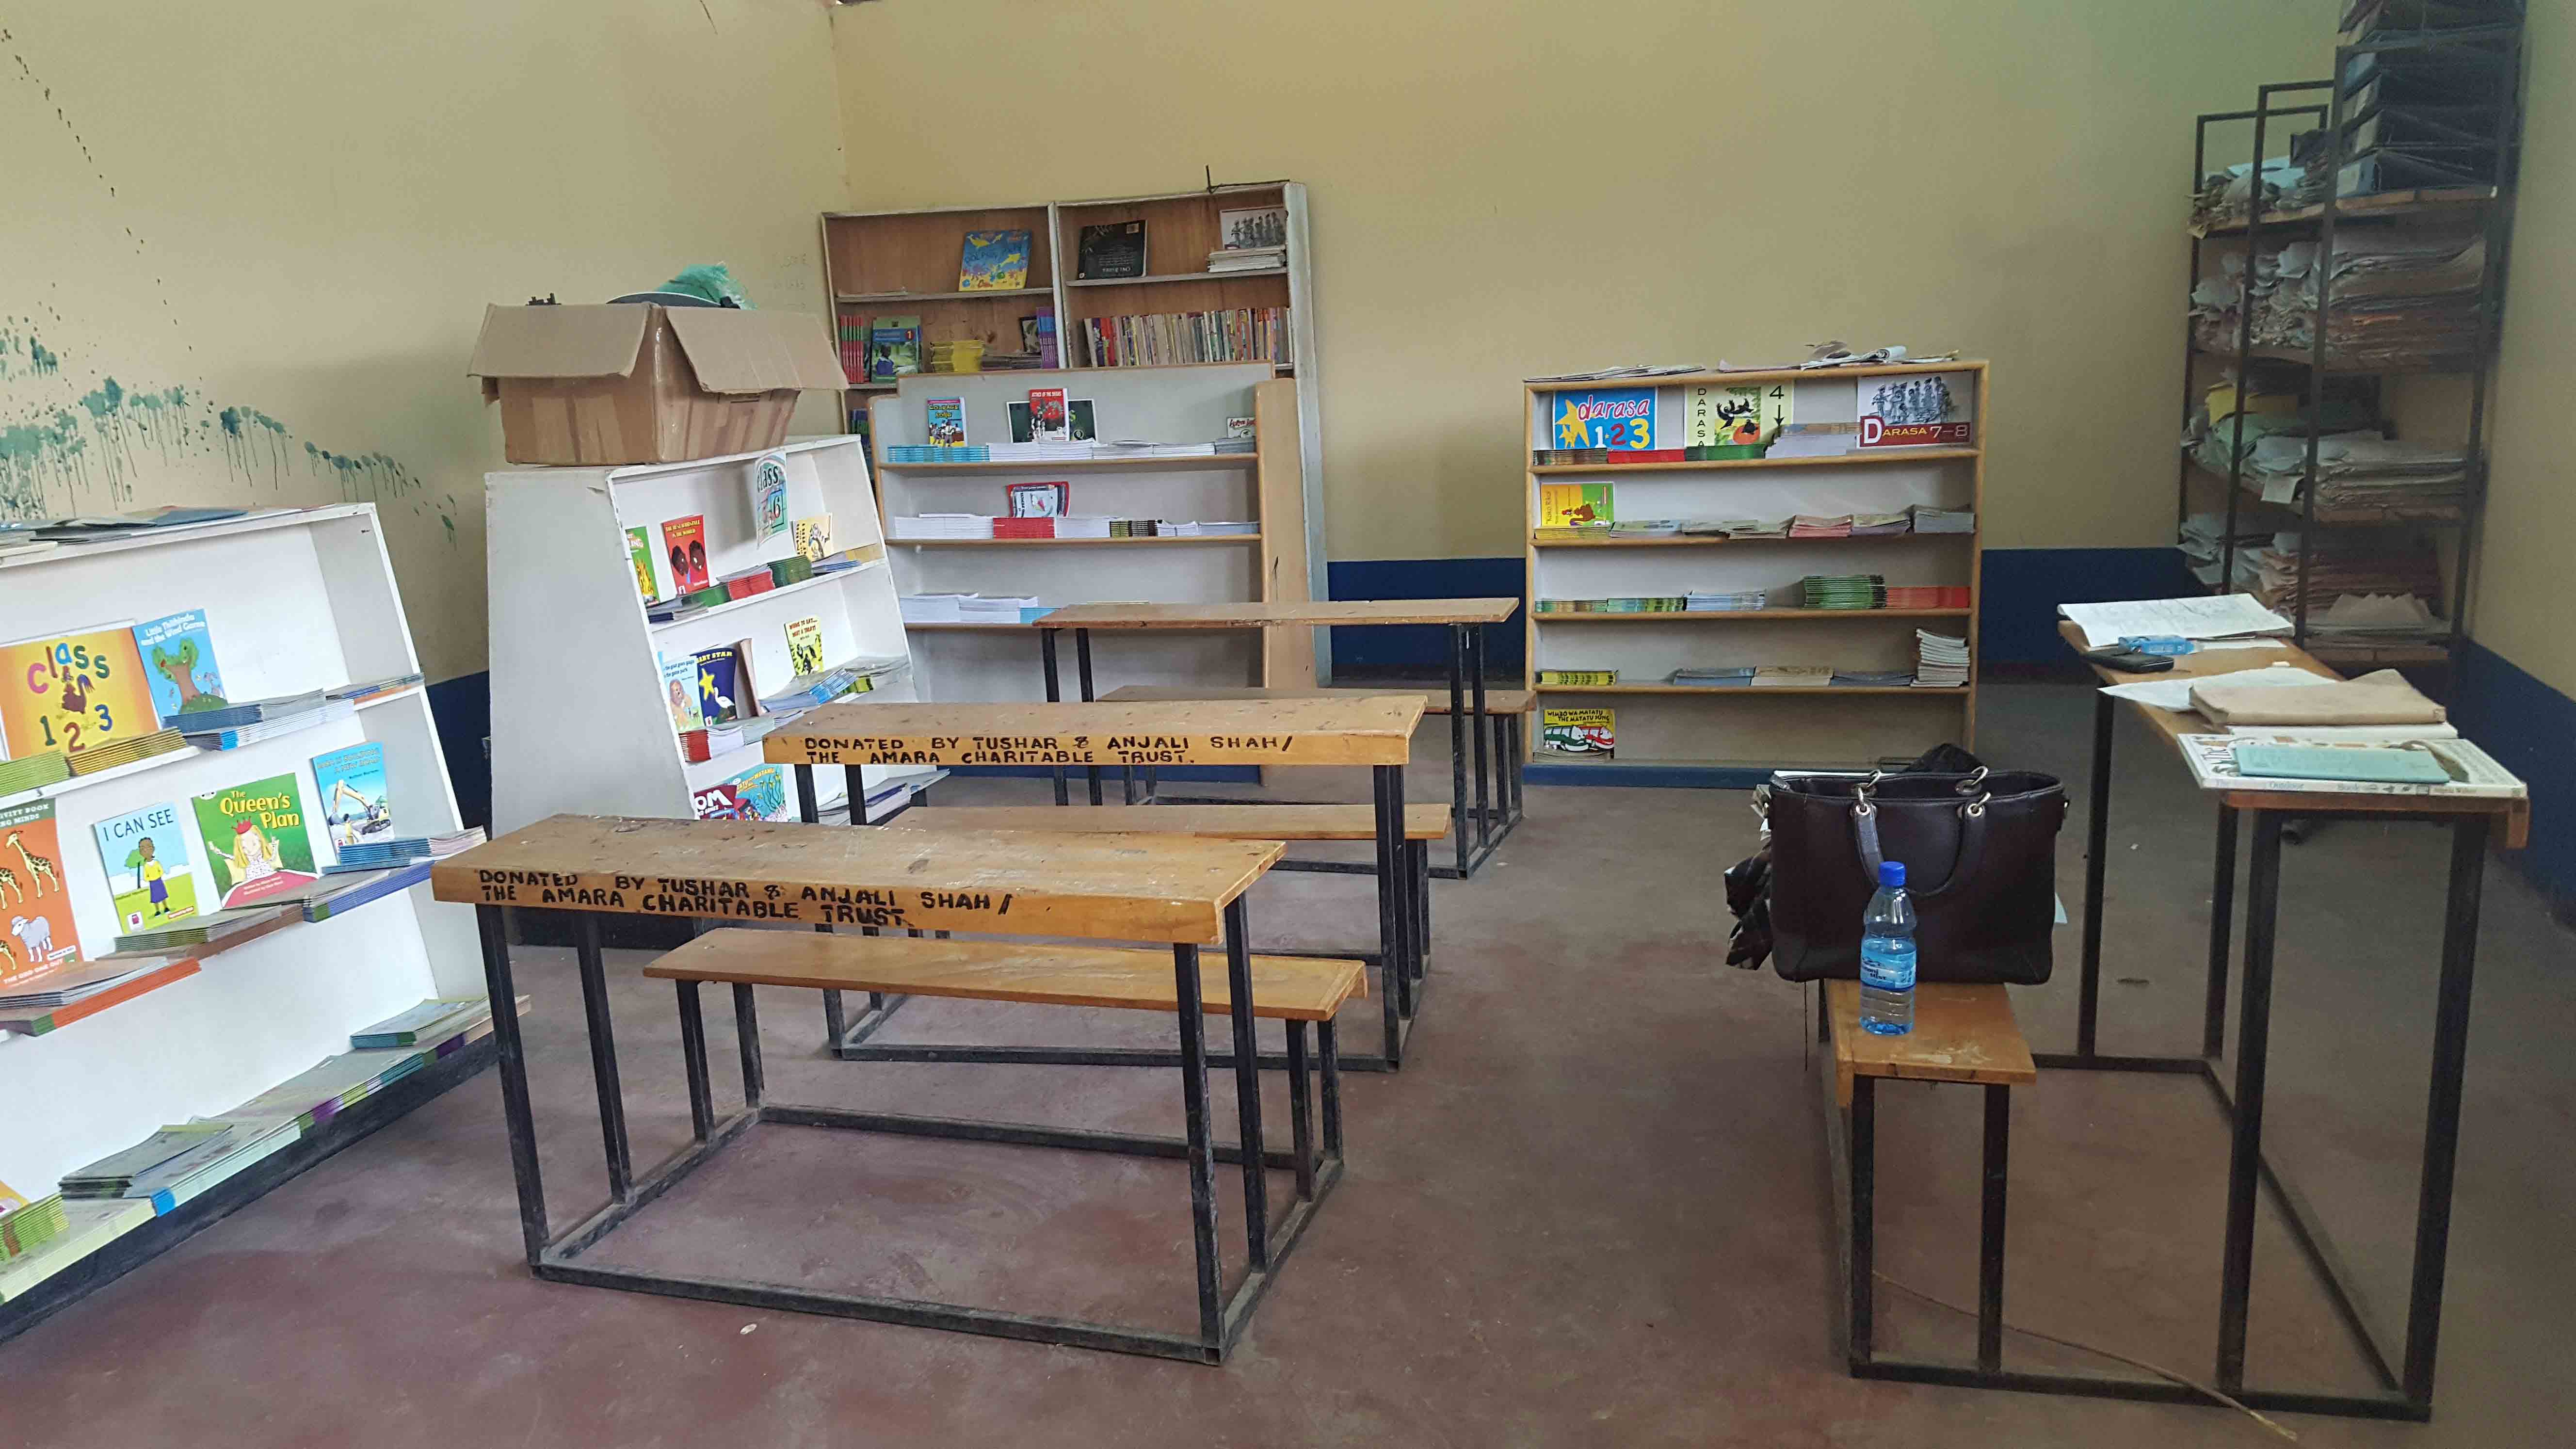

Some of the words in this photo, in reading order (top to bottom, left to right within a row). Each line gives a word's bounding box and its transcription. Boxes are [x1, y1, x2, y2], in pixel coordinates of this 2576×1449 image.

[907, 330, 912, 339] 1
[1770, 386, 1784, 399] 4
[1578, 394, 1650, 421] darasa
[1697, 388, 1707, 447] DARASA
[1594, 426, 1607, 448] 1
[1611, 423, 1626, 446] 2
[1629, 418, 1650, 450] 3
[1864, 418, 1927, 444] DARASA
[773, 496, 781, 518] 6
[28, 643, 110, 694] class
[40, 715, 57, 746] 1
[64, 722, 86, 753] 2
[95, 704, 113, 731] 3
[805, 737, 904, 750] DONATED
[932, 737, 960, 749] BY
[972, 737, 1059, 750] TUSHAR
[1107, 736, 1190, 749] ANJALI
[807, 752, 840, 764] THE
[869, 752, 940, 763] AMARA
[961, 751, 1095, 763] CHARITABLE
[220, 791, 291, 817] Queen's
[230, 790, 246, 799] The
[25, 803, 49, 814] BOOK
[260, 811, 300, 829] Plan
[103, 827, 110, 841] I
[114, 817, 145, 838] CAN
[147, 808, 174, 828] SEE
[478, 869, 578, 887] DONATED
[615, 875, 645, 890] BY
[657, 877, 750, 898] TUSHAR
[801, 886, 896, 905] ANJALI
[481, 885, 517, 902] THE
[542, 887, 625, 908] AMARA
[643, 894, 800, 919] CHARITABLE
